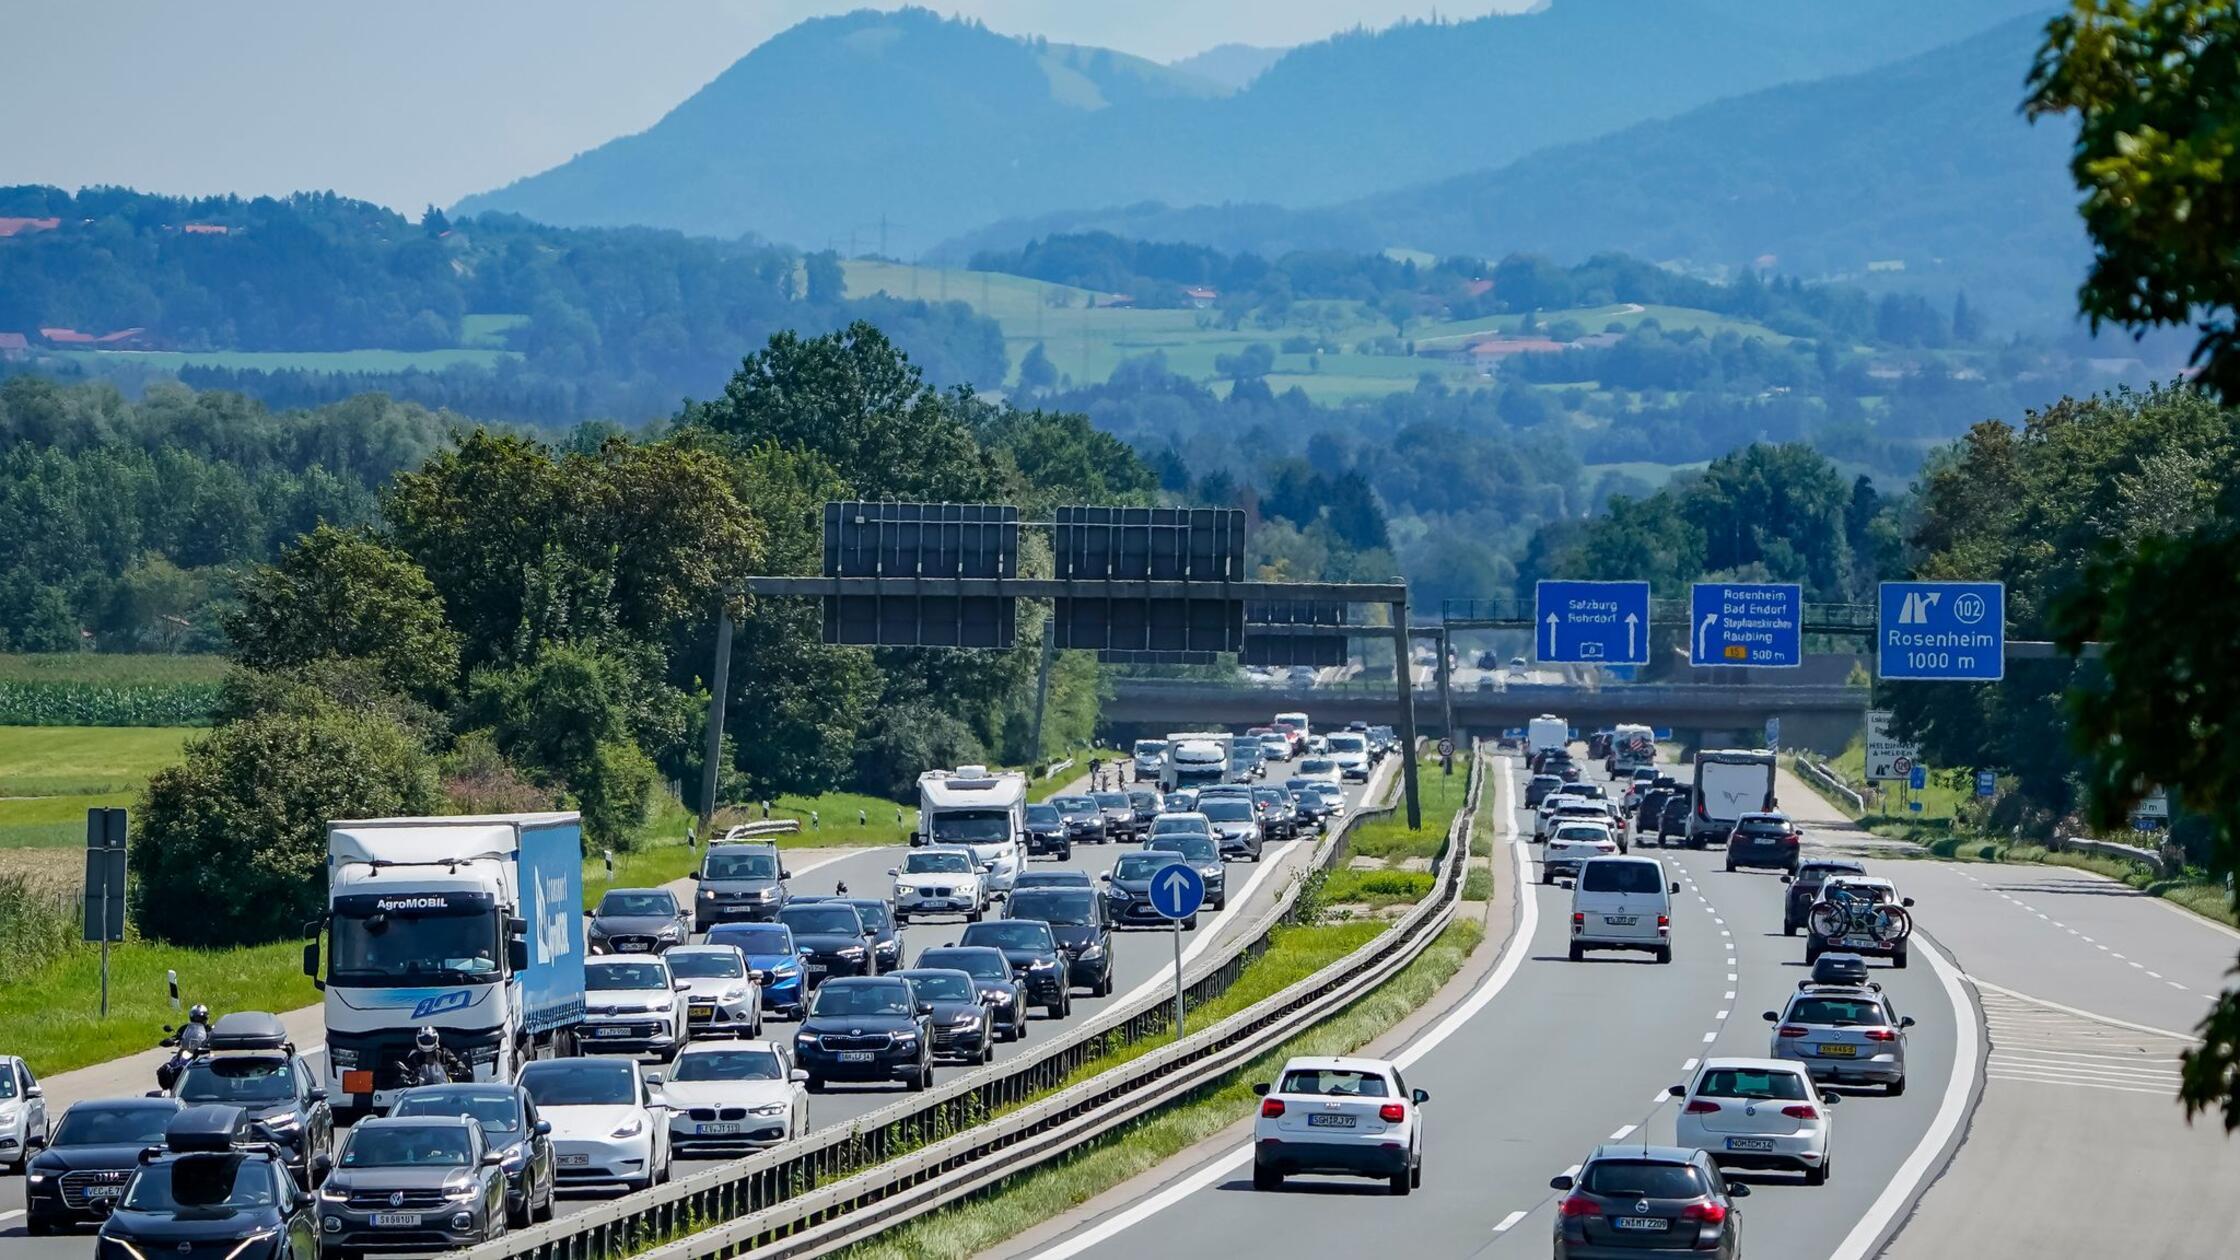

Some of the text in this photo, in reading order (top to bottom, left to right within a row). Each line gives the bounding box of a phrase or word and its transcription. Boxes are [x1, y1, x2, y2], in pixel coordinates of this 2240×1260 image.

[1724, 588, 1786, 600] Rosenheim
[1568, 599, 1618, 613] Salzburg
[1723, 603, 1787, 615] Bad Endorf
[1957, 600, 1980, 617] 102
[1723, 631, 1773, 644] Raubling
[1888, 630, 1994, 647] Rosenheim
[1752, 649, 1772, 660] 500
[1774, 652, 1785, 660] m
[1907, 652, 1975, 669] 1000 m
[377, 897, 448, 910] AgroMOBIL
